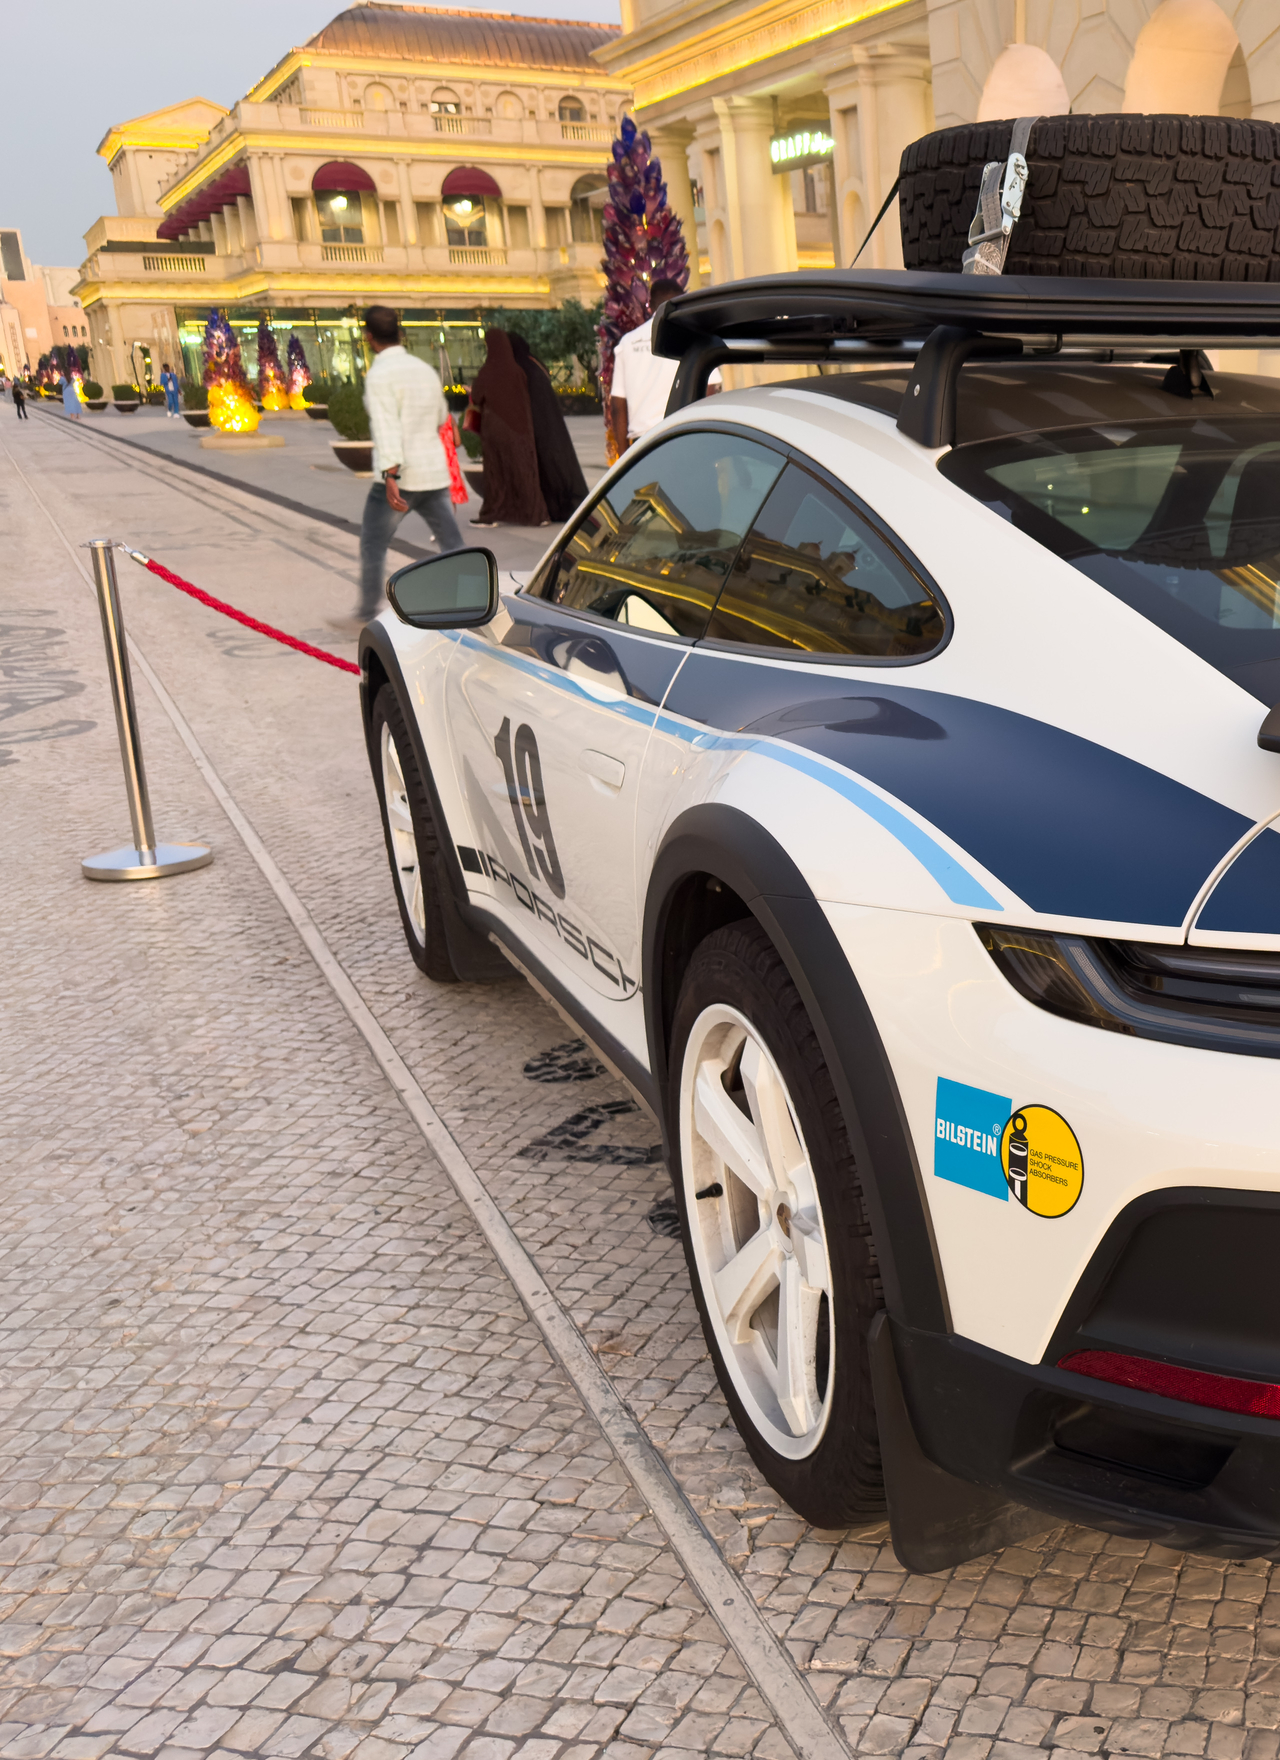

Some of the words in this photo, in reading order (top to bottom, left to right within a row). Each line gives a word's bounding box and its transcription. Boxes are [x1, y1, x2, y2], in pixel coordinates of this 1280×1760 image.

[494, 716, 566, 900] 19
[936, 1117, 997, 1157] BILSTEIN
[1029, 1148, 1044, 1160] GAS
[1044, 1153, 1079, 1171] PRESSURE
[1029, 1158, 1053, 1172] SHOCK
[1029, 1168, 1068, 1187] ABSORBERS
